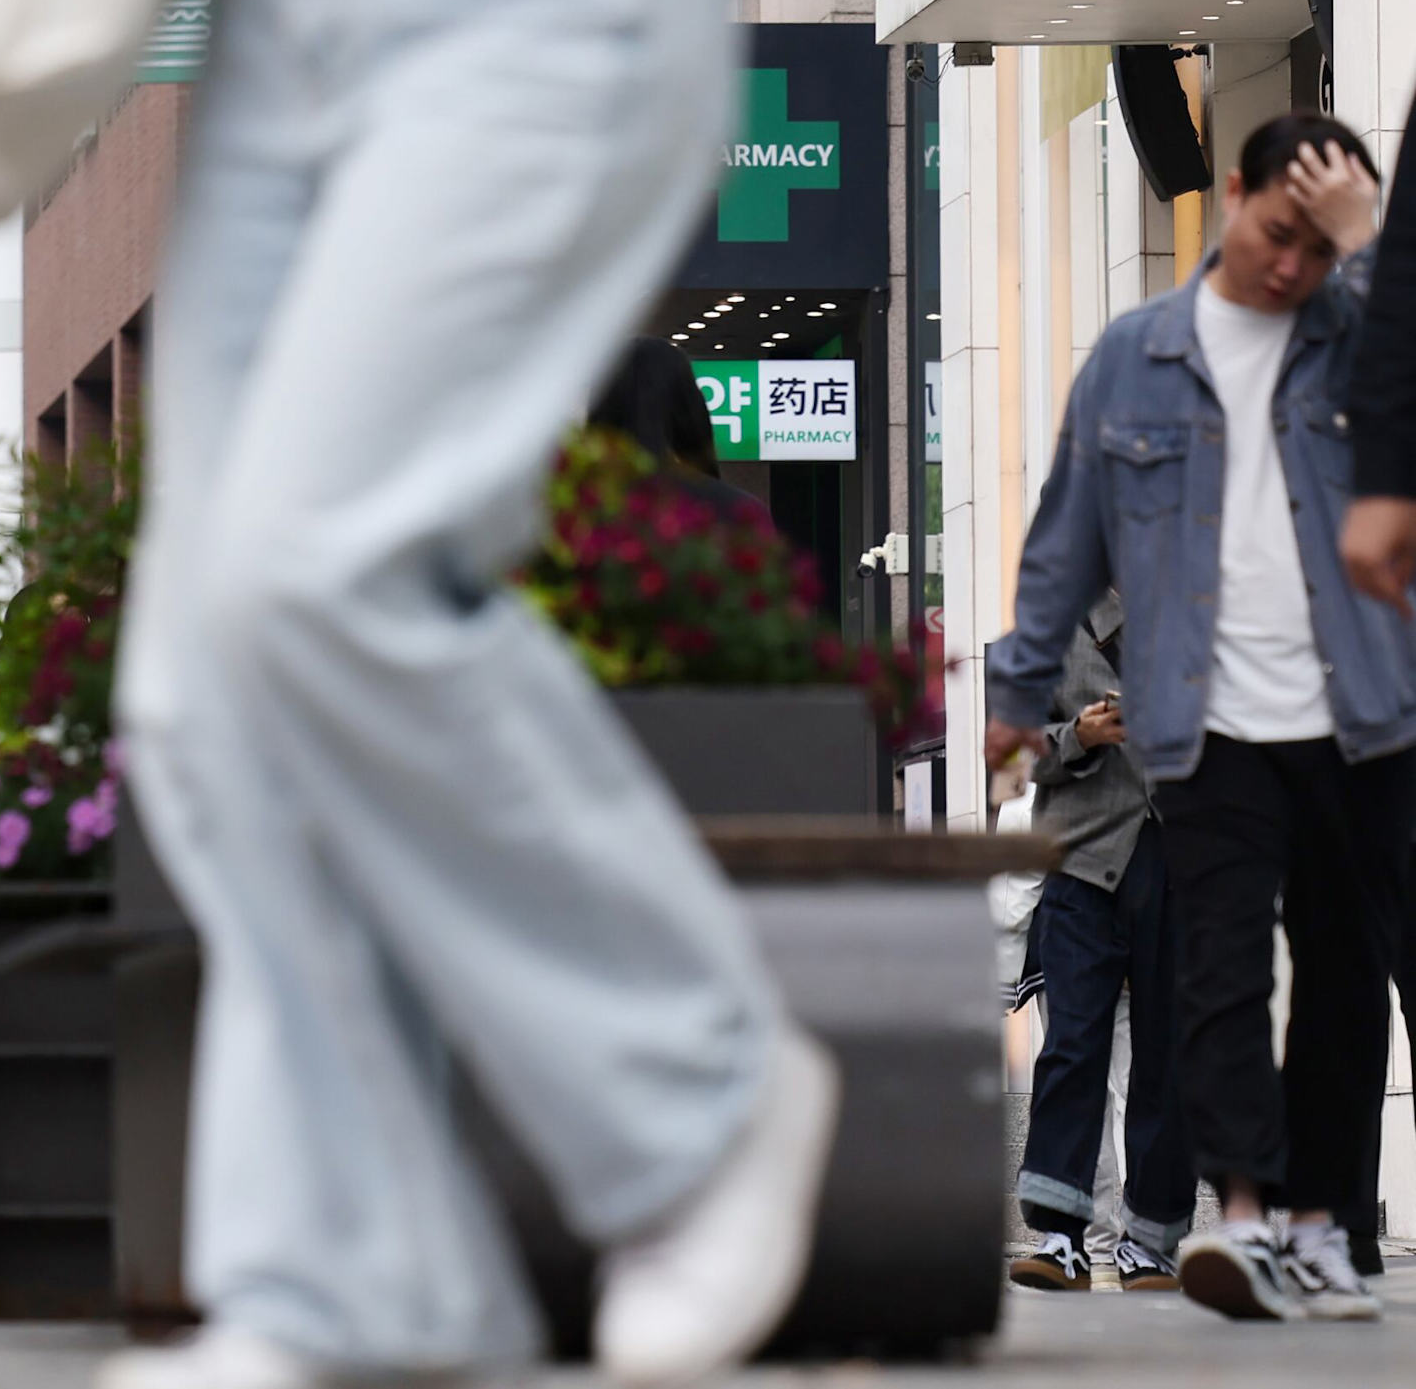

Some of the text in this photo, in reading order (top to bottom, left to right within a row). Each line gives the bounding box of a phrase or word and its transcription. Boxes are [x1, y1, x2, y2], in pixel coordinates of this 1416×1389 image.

[695, 376, 752, 444] 약
[769, 377, 849, 416] 药店
[764, 430, 852, 443] PHARMACY
